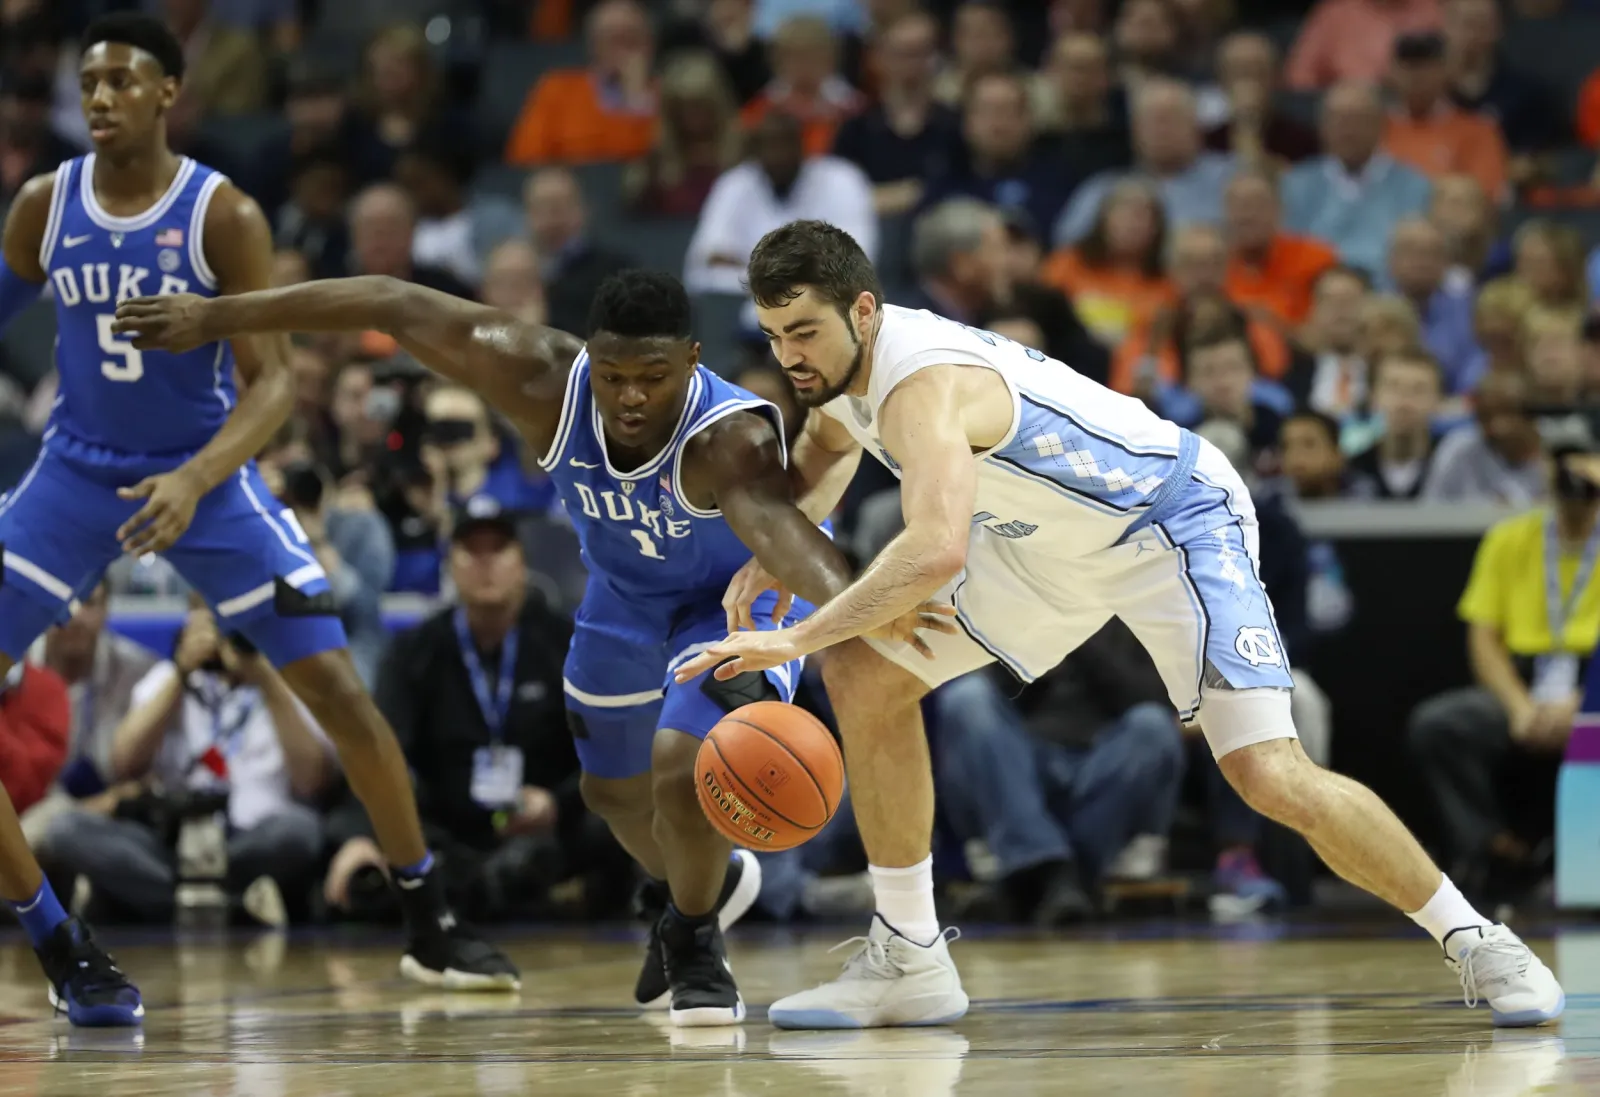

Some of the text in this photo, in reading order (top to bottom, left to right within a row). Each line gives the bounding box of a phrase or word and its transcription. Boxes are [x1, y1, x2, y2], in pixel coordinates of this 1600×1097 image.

[96, 314, 143, 382] 5
[574, 482, 691, 539] DUKE
[631, 530, 665, 560] 1
[704, 771, 775, 842] TF-1000
